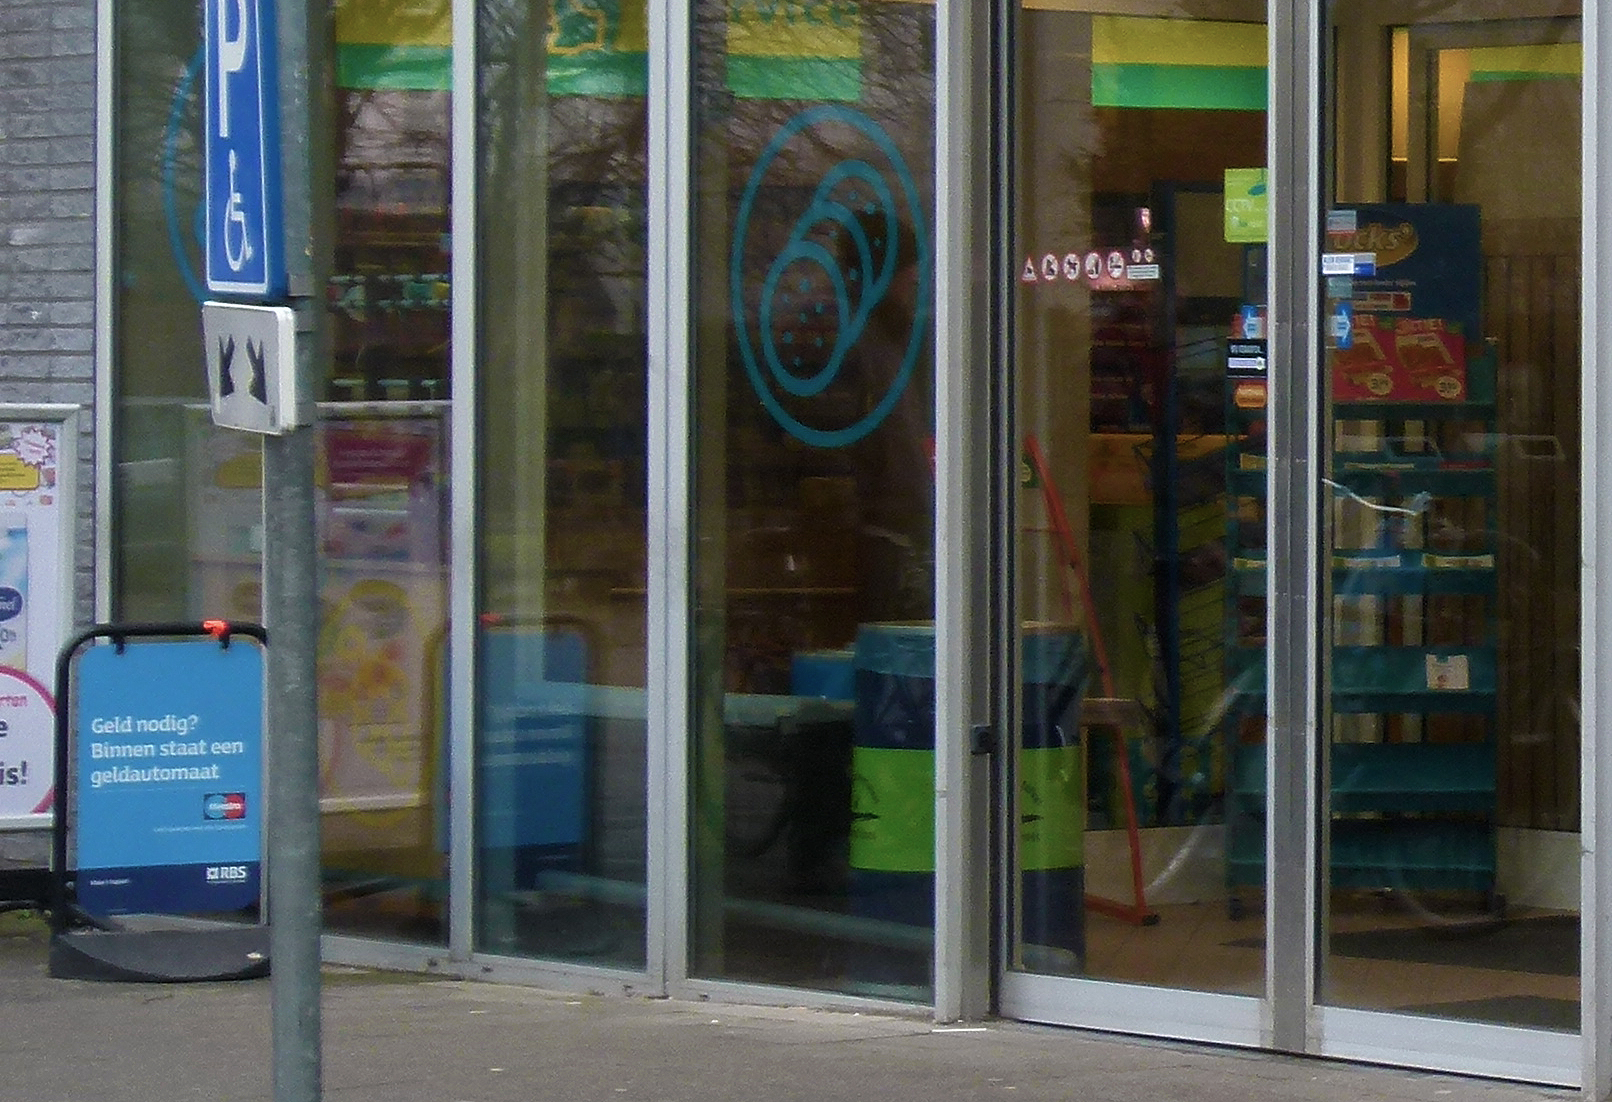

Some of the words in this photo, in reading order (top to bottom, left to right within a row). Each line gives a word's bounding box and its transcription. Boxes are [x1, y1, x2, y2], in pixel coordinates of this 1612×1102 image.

[91, 715, 132, 734] Geld
[136, 713, 199, 736] nodig?
[91, 741, 155, 759] Binnen
[159, 739, 208, 757] staat
[210, 740, 244, 755] een
[90, 763, 220, 788] geldautomaat
[219, 865, 248, 879] RBS
